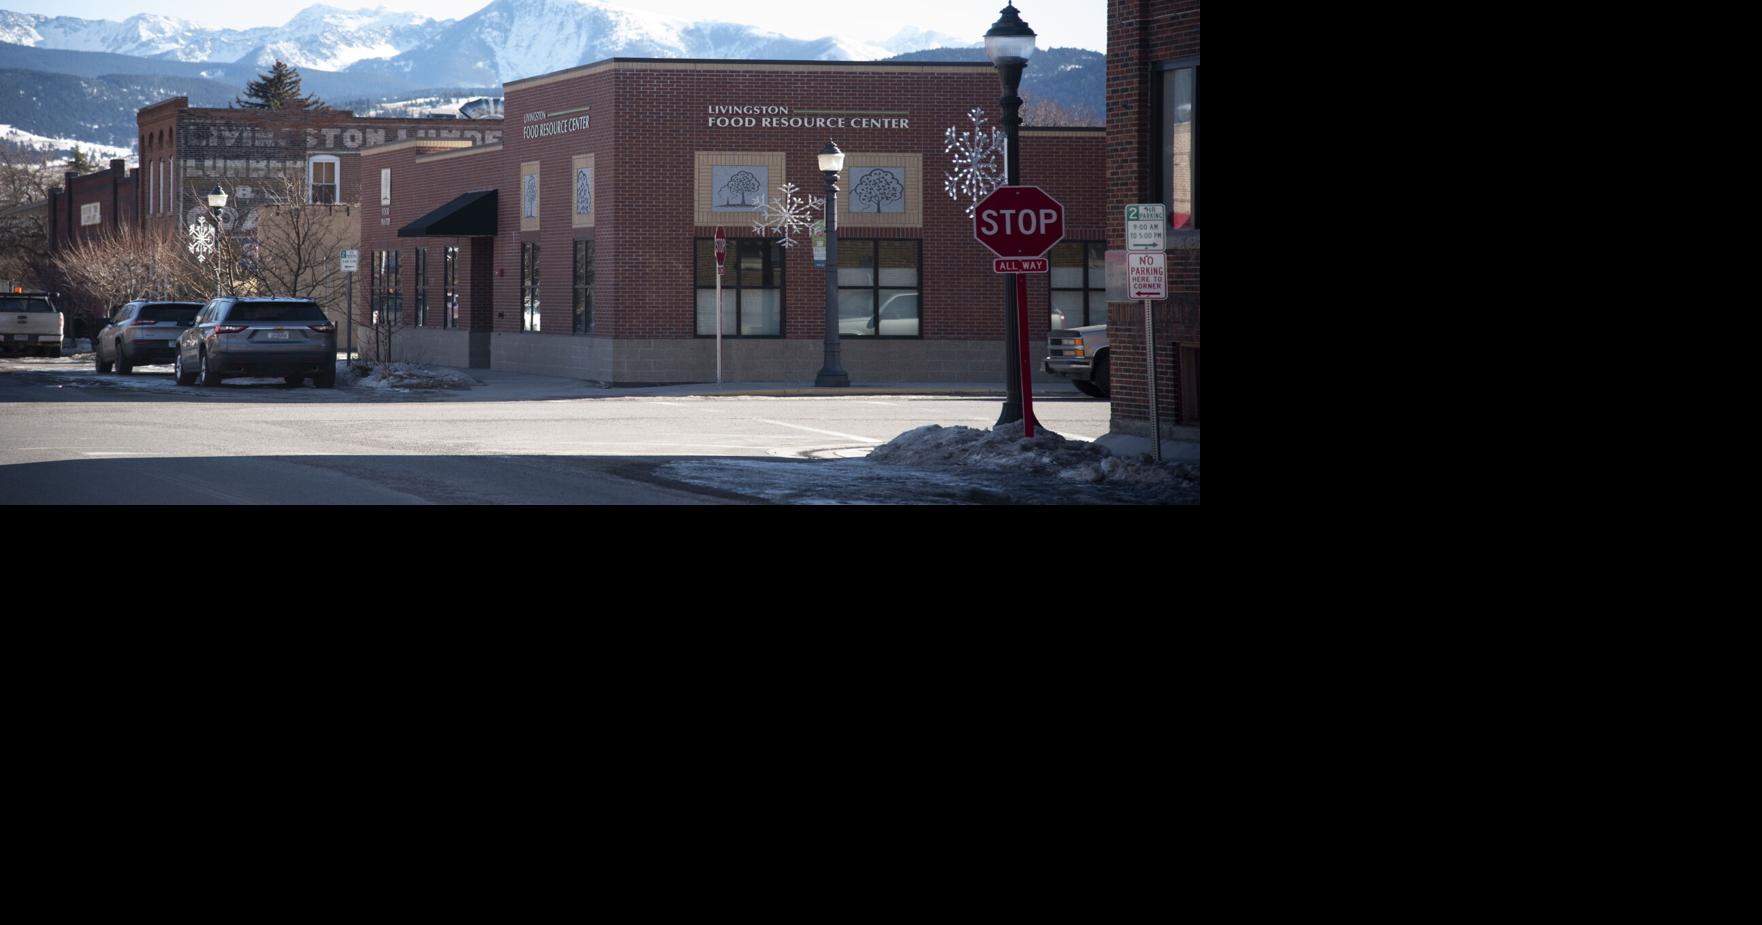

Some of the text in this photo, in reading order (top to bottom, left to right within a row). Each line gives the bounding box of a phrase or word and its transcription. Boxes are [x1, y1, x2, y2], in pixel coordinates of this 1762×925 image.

[708, 105, 789, 114] LIVINGSTON
[523, 111, 546, 123] LIVINGSTON
[708, 117, 910, 129] FOOD RESOURCE CENTER
[523, 115, 590, 139] FOOD RESOURCE CENTER
[1128, 207, 1138, 219] 2
[981, 209, 1058, 236] STOP
[1000, 261, 1042, 270] ALL WAY
[1139, 256, 1154, 265] NO
[1131, 267, 1163, 275] PARKING
